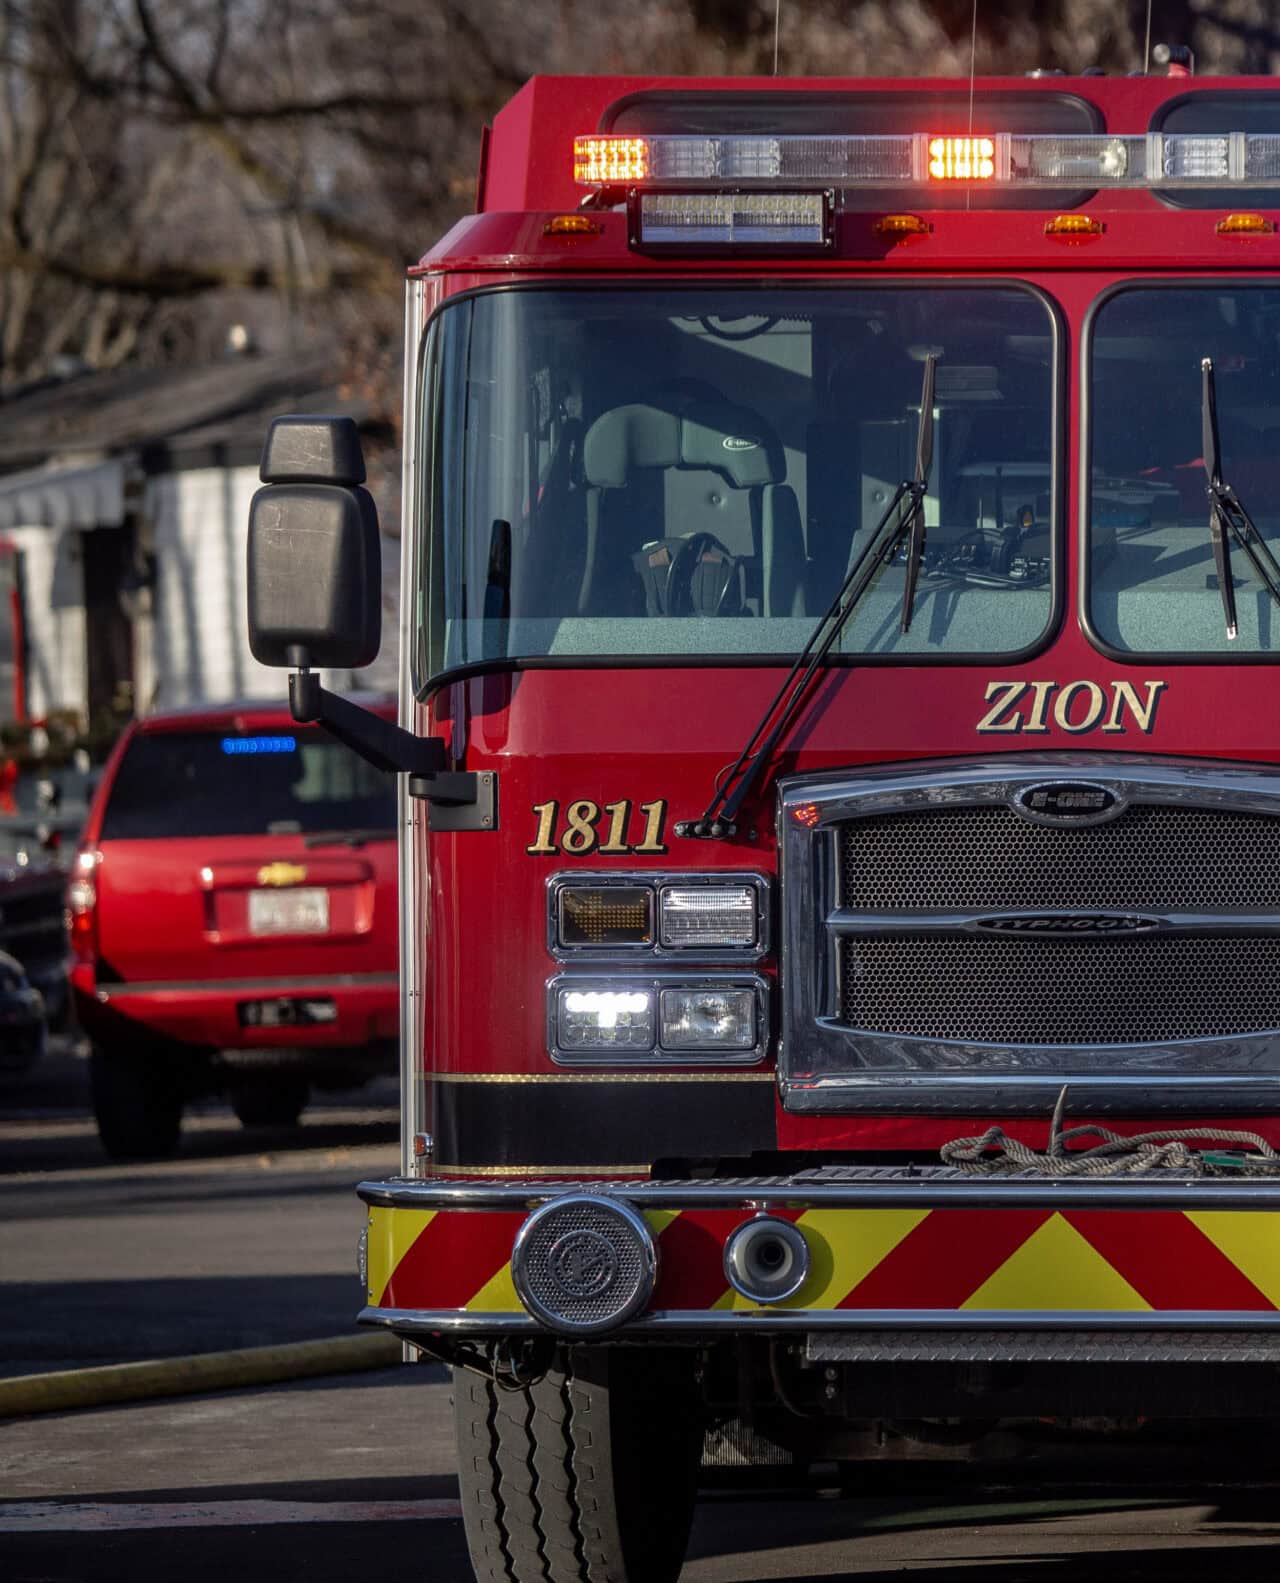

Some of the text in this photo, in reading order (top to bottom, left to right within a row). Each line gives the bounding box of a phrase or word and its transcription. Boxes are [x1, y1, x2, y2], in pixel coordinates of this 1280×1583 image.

[975, 680, 1168, 734] ZION
[1030, 791, 1106, 808] E-ONE
[526, 799, 668, 855] 1811
[992, 918, 1136, 930] TYPHOON
